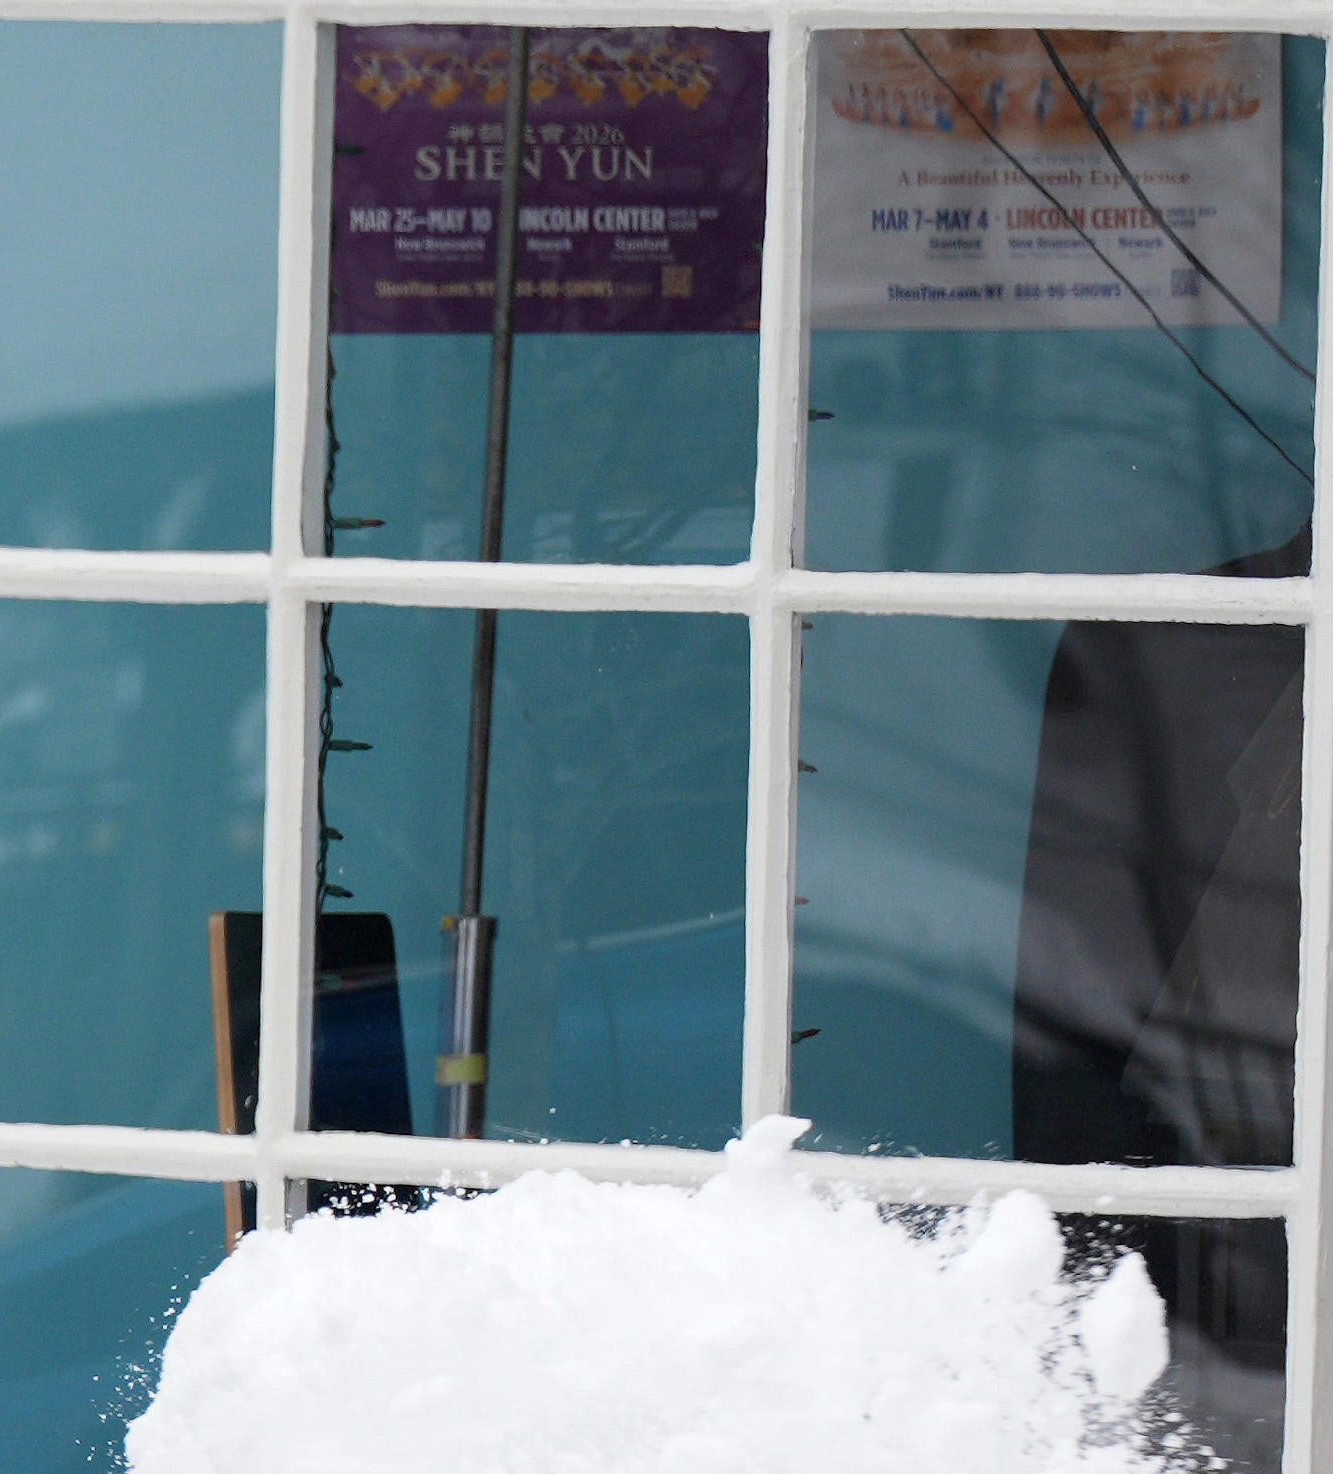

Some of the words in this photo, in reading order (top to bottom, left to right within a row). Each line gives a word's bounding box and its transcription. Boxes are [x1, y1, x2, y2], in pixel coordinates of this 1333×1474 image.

[414, 145, 543, 181] SHEN
[558, 145, 654, 181] YUN
[1090, 169, 1192, 189] Exprience
[349, 207, 392, 232] MAR
[518, 206, 589, 232] INCOLN
[593, 206, 665, 232] CENTER
[872, 208, 909, 230] MAR
[977, 208, 988, 230] 4
